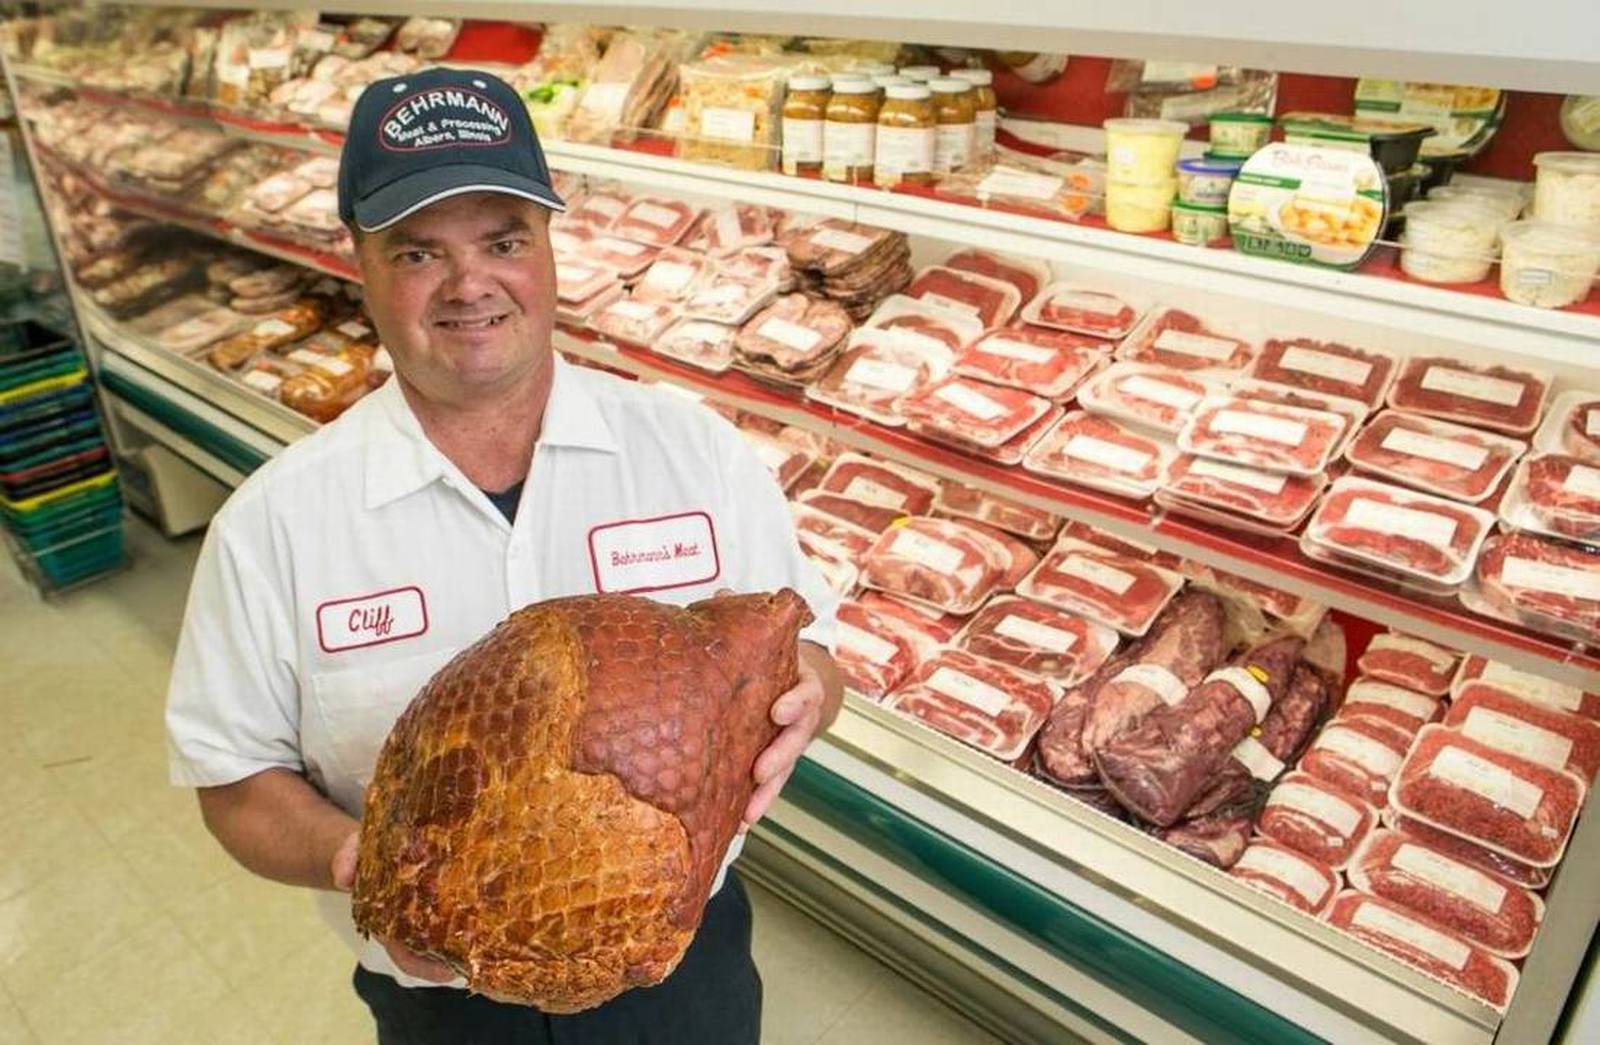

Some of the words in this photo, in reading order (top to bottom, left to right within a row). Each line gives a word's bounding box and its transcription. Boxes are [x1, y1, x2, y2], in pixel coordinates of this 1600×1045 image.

[384, 91, 508, 139] BEHRMANN
[441, 118, 502, 136] Processing
[348, 605, 394, 636] Cliff
